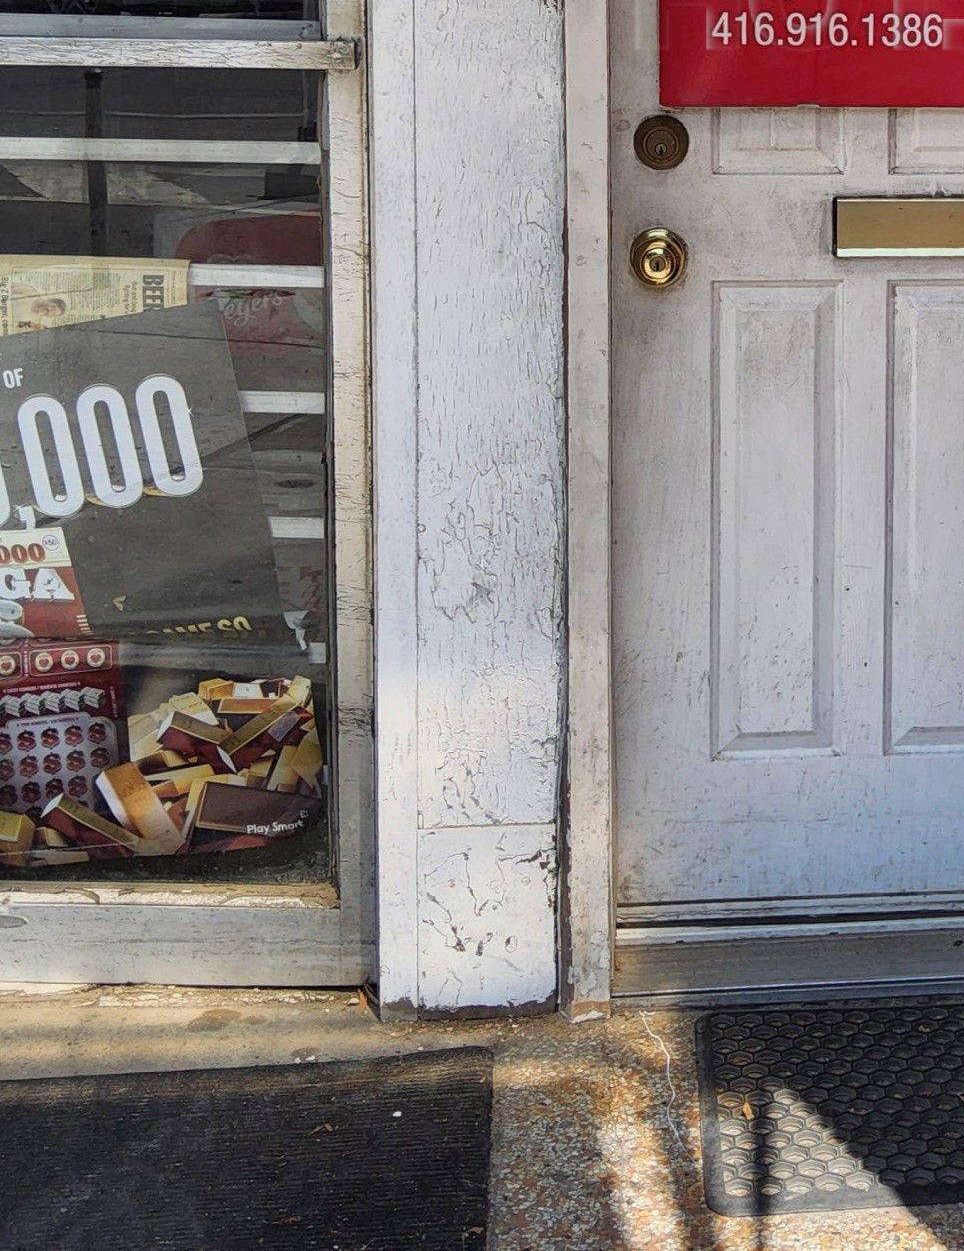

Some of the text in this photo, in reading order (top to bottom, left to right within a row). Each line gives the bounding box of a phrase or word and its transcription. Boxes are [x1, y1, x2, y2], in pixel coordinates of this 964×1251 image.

[711, 12, 944, 48] 416.916.1386
[3, 368, 23, 389] OF
[246, 820, 304, 835] Play Smart
